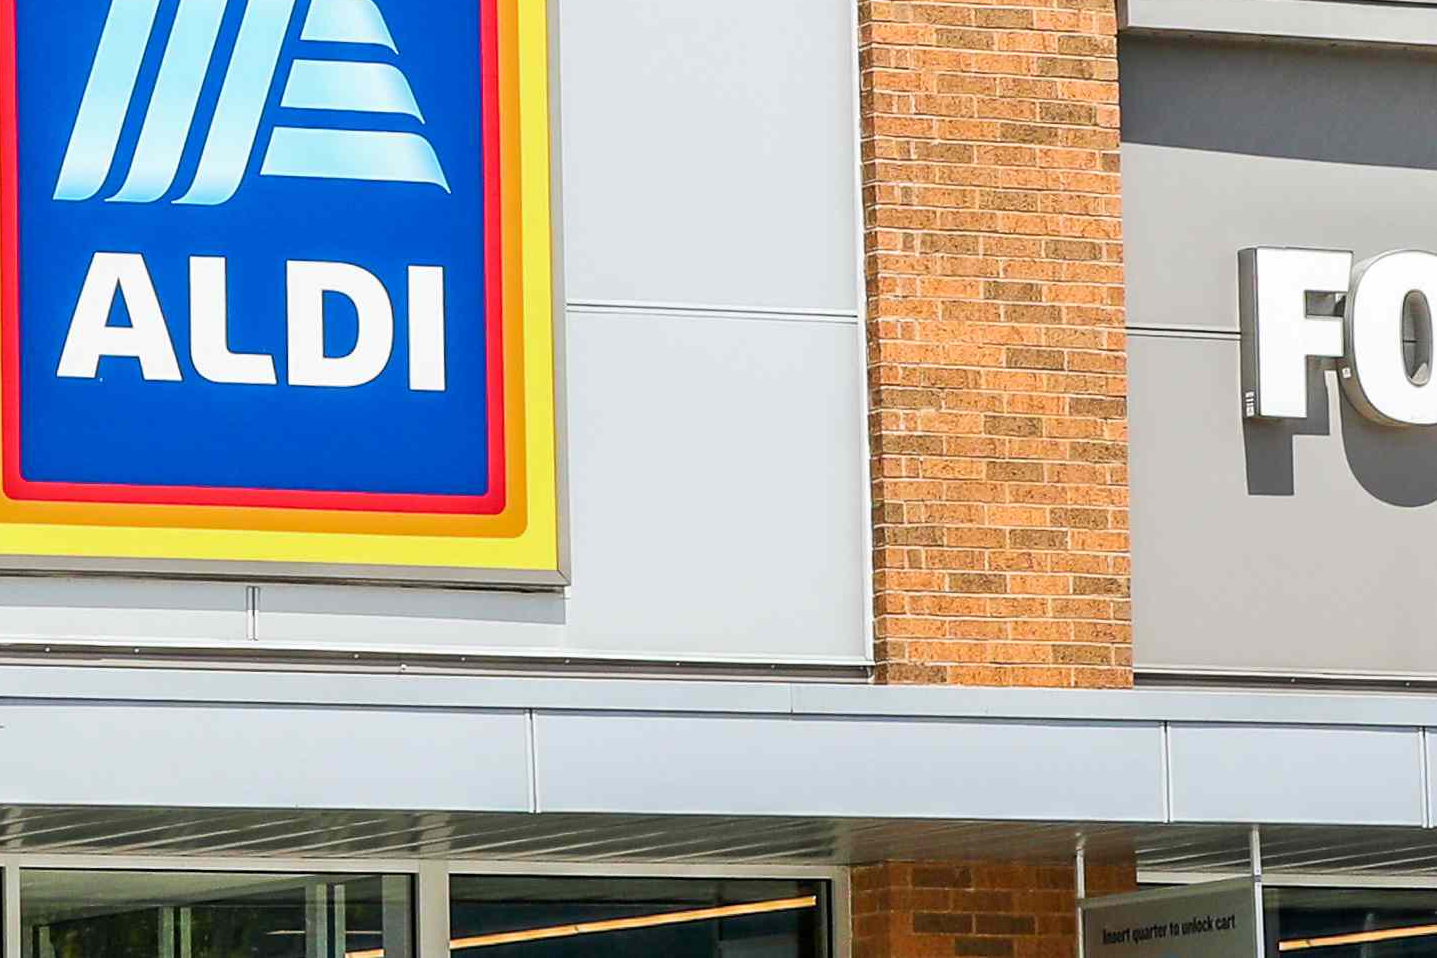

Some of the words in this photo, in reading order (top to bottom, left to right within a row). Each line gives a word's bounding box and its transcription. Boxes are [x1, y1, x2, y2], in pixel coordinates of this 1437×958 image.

[56, 250, 447, 392] ALDI
[1102, 927, 1130, 944] Insert
[1132, 923, 1168, 944] quarter
[1169, 921, 1180, 937] to
[1181, 916, 1213, 935] unlock
[1215, 914, 1236, 930] cart
